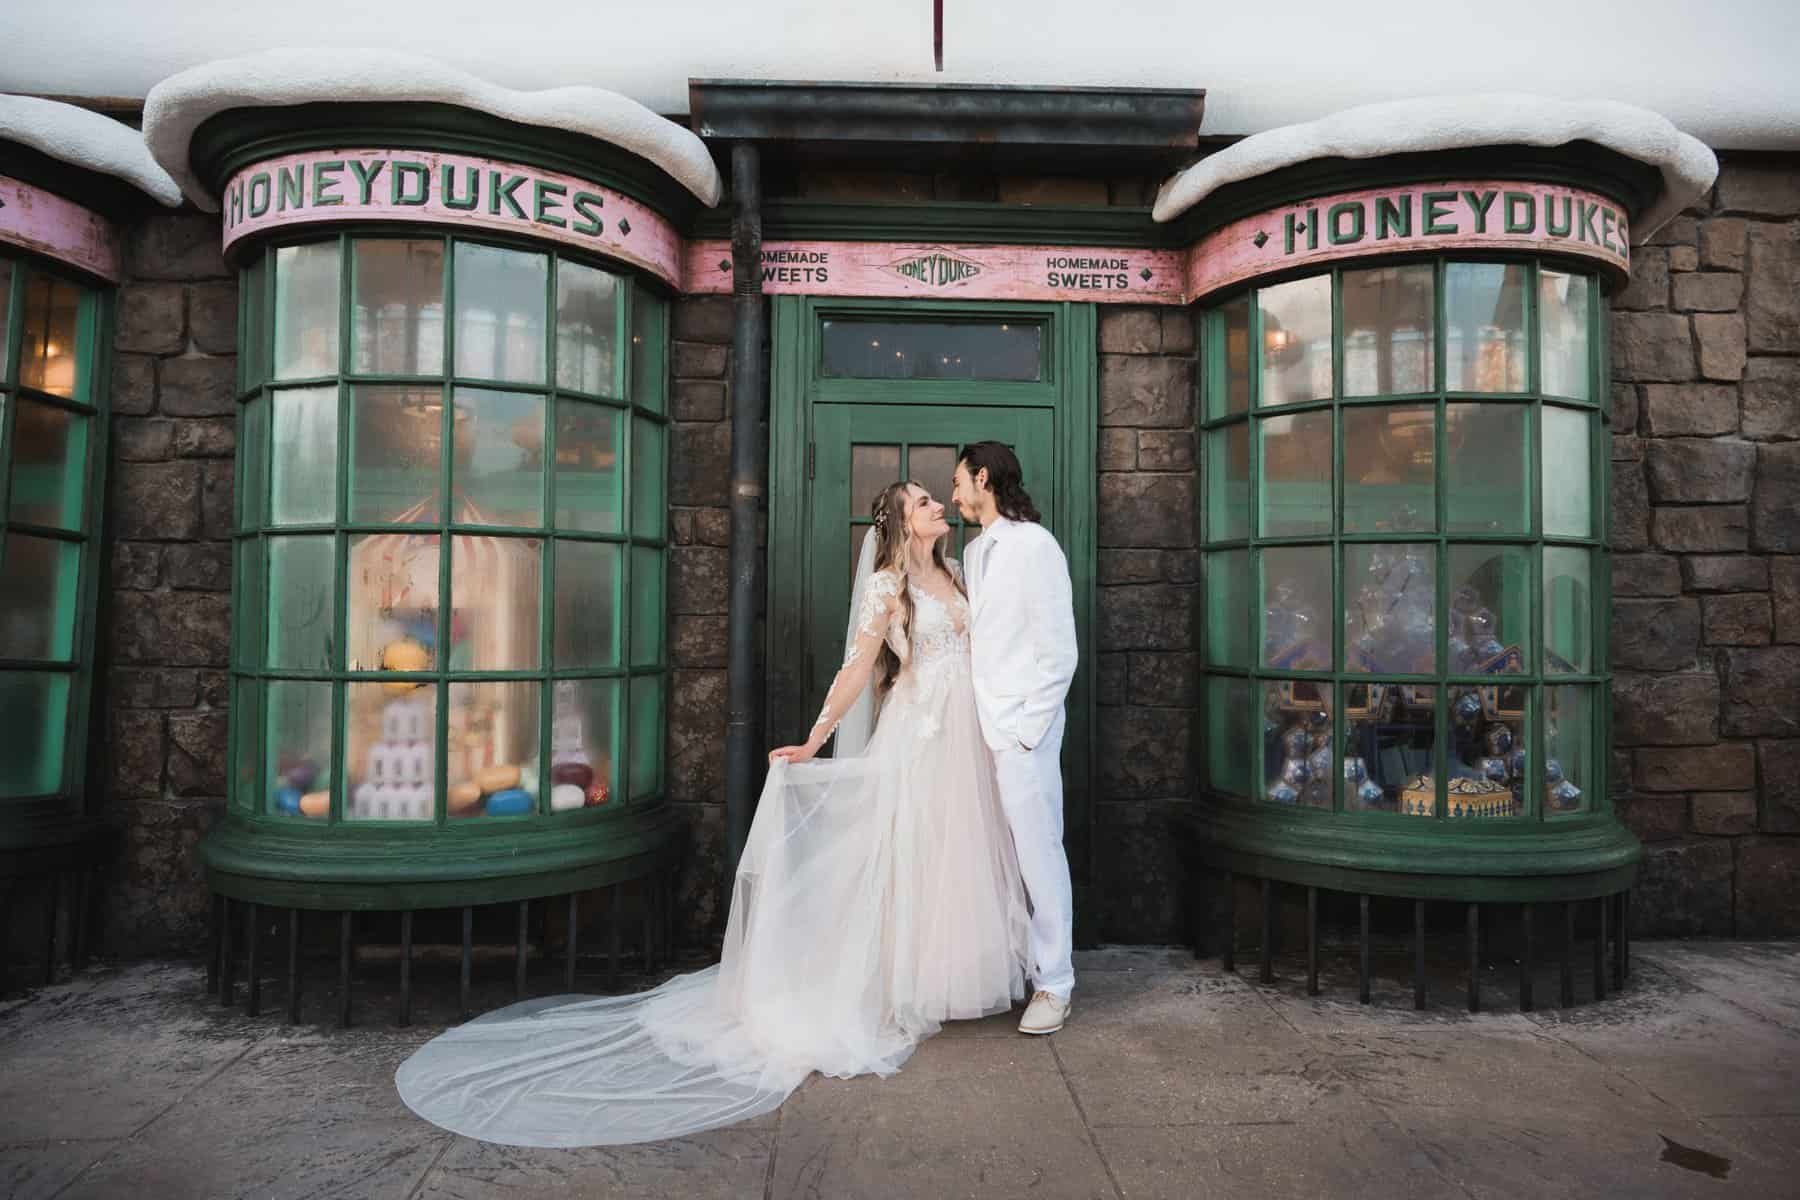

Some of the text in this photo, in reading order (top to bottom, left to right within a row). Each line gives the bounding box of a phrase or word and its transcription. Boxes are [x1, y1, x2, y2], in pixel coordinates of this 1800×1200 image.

[230, 160, 604, 236] HONEYDUKES
[1284, 190, 1628, 257] HONEYDUKES
[760, 252, 829, 263] OMEMADE
[1047, 258, 1129, 270] HOMEMADE
[760, 267, 828, 282] WEETS
[1047, 272, 1129, 289] SWEETS
